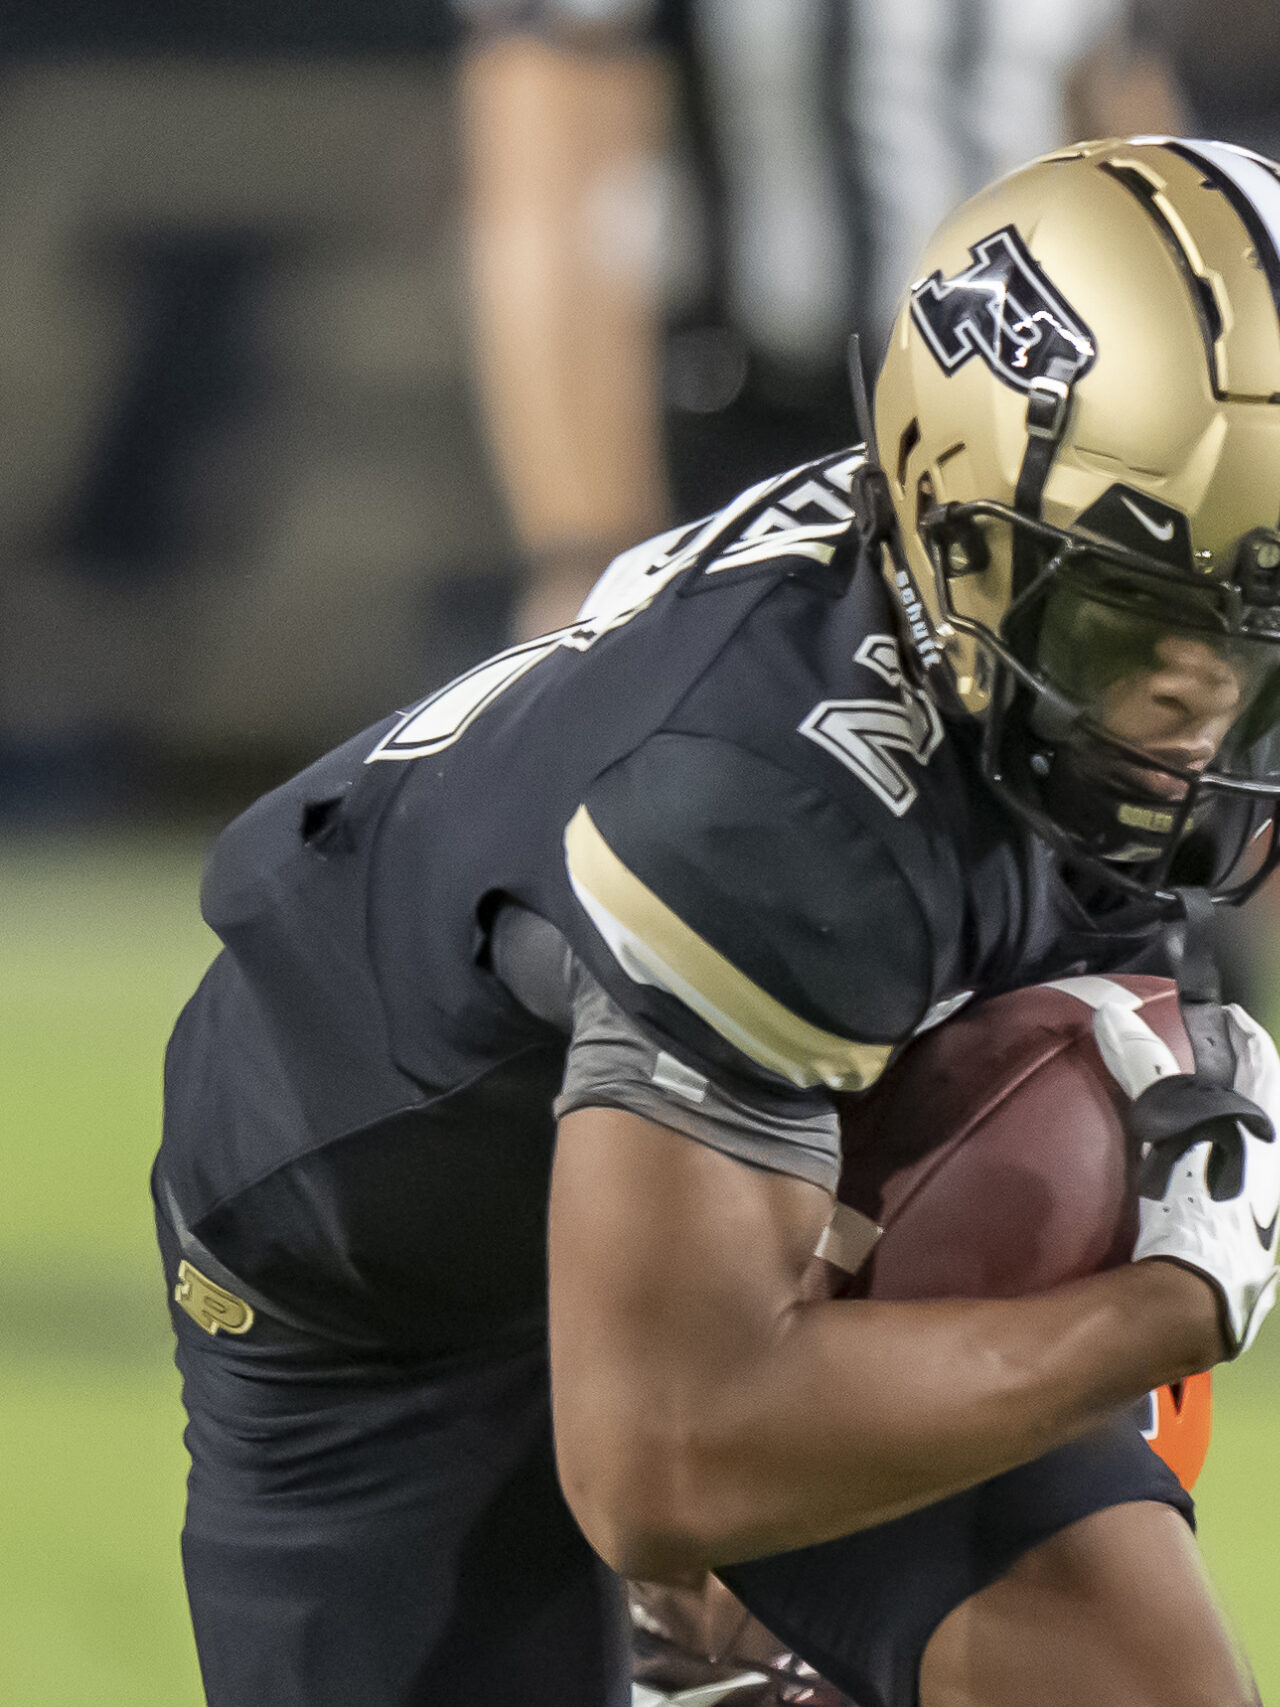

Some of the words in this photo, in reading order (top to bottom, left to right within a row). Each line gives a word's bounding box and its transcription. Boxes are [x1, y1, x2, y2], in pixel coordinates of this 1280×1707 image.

[911, 223, 1098, 393] P
[798, 633, 945, 817] 2
[175, 1259, 254, 1335] P
